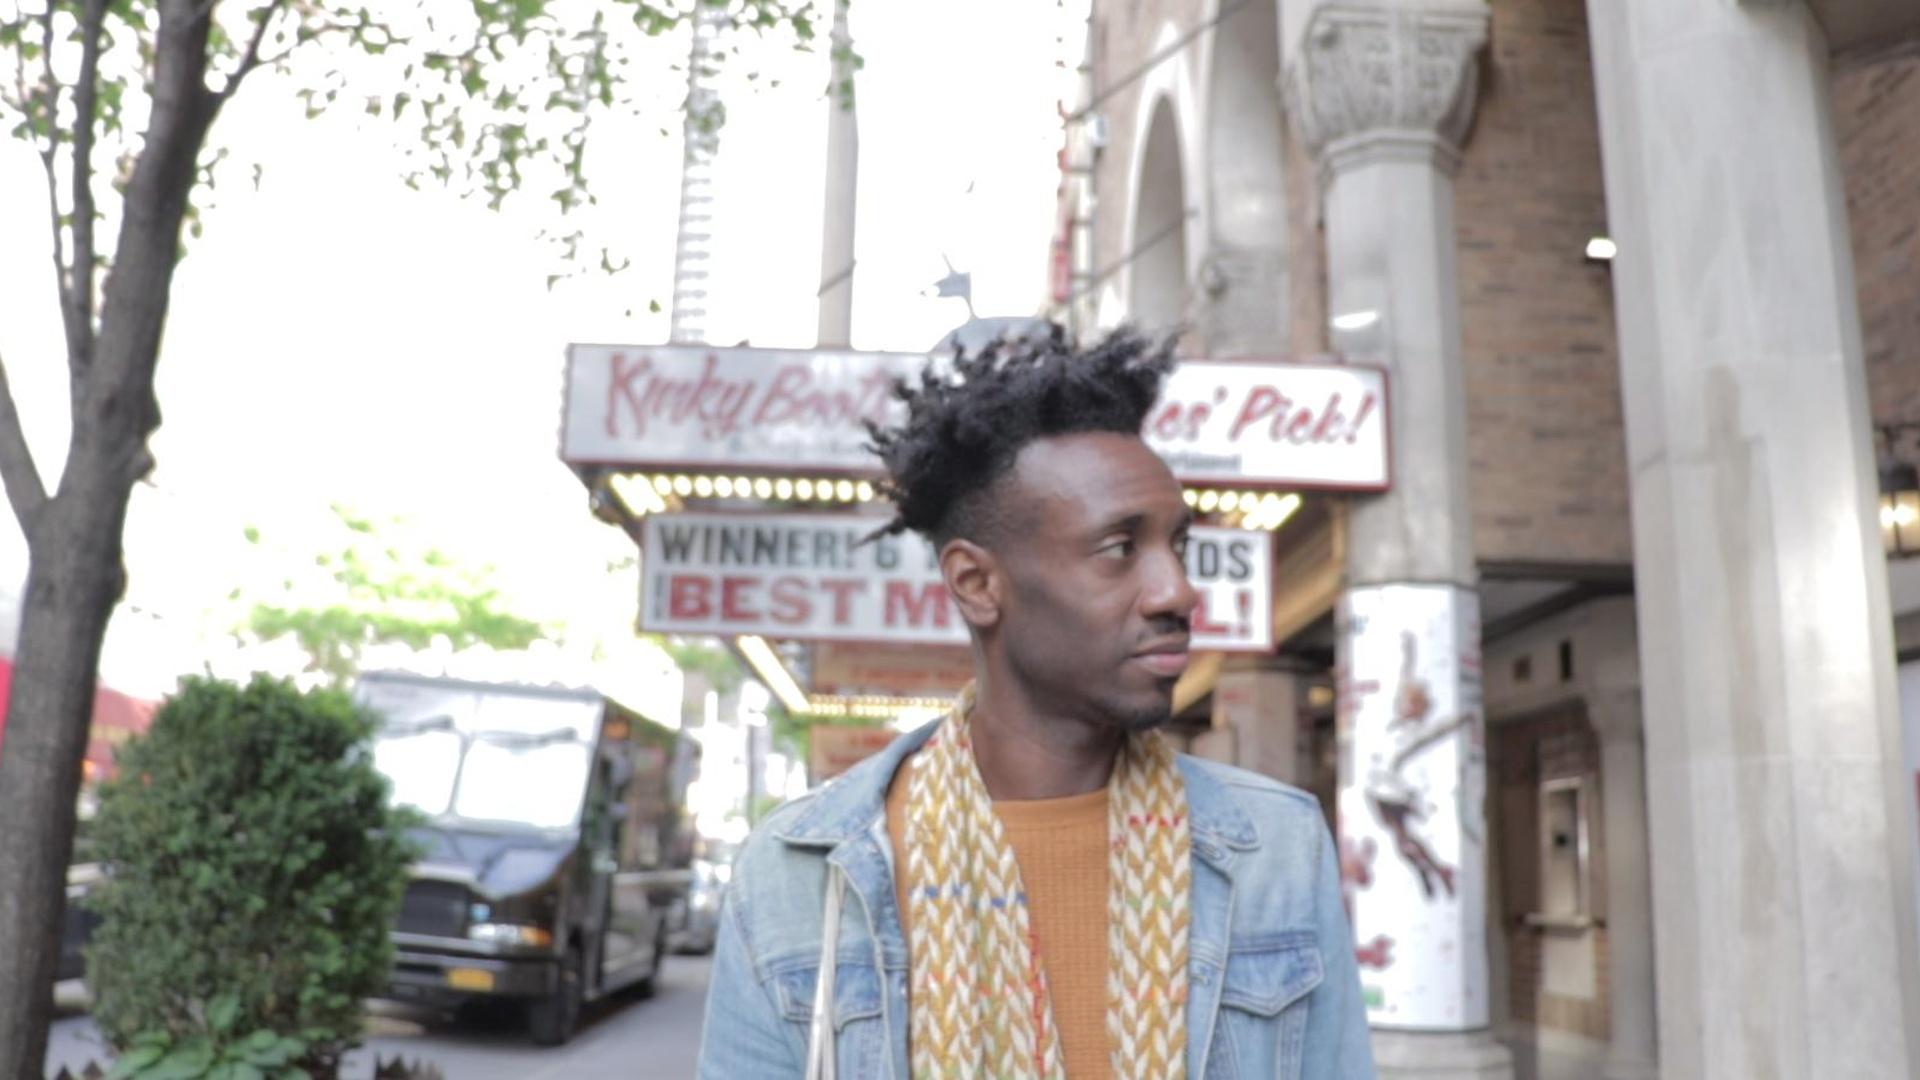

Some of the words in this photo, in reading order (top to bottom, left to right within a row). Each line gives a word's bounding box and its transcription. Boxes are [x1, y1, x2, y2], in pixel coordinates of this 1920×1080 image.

[1227, 384, 1376, 445] Pick!
[658, 523, 856, 570] WINNER!
[1198, 538, 1255, 583] DS
[668, 574, 867, 626] BEST
[882, 579, 955, 630] M
[1192, 588, 1253, 637] L!
